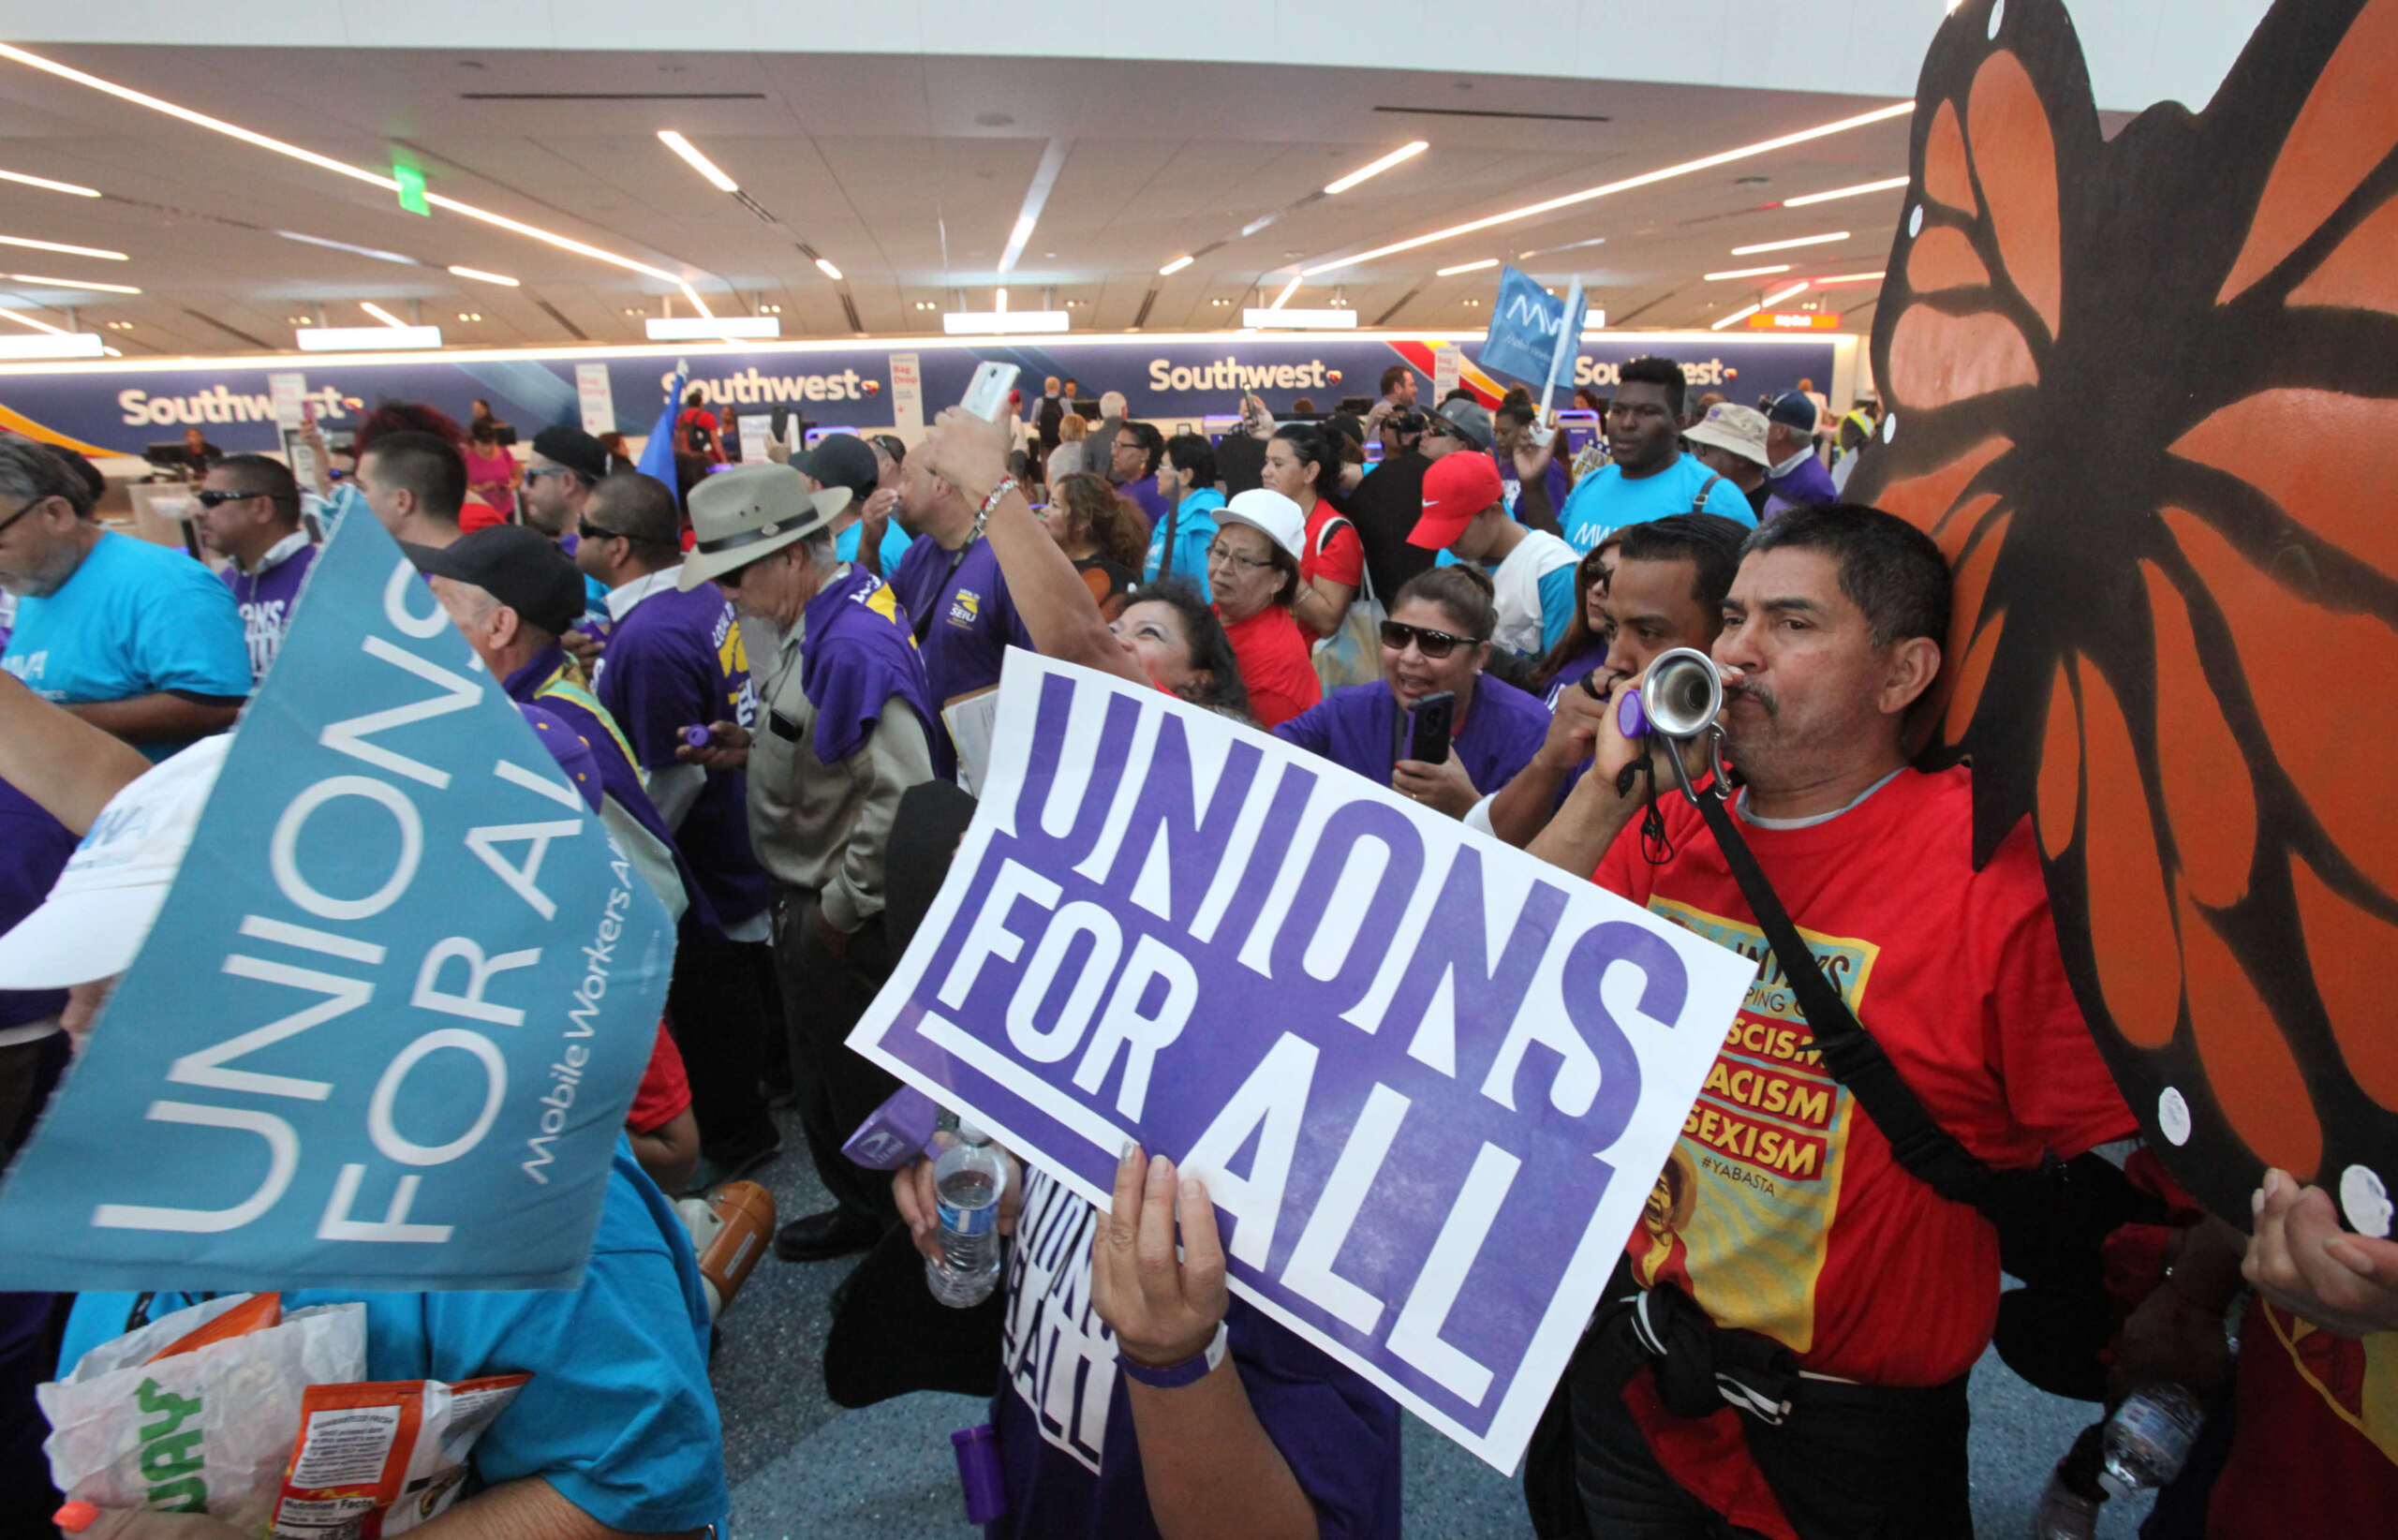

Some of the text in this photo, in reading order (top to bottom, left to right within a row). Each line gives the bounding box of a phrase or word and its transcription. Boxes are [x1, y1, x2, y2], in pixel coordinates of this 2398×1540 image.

[118, 385, 346, 425] Southwst
[1148, 357, 1326, 392] Southwest
[938, 856, 1199, 1122] FOR
[1013, 672, 1689, 1156] UNIONS
[317, 937, 540, 1242] FOR
[521, 1044, 590, 1185] Mobile
[563, 886, 631, 1038] Workers
[1703, 1062, 1830, 1124] ACISM
[1176, 1030, 1523, 1409] ALL
[1681, 1105, 1817, 1177] SEXISM
[1700, 1155, 1776, 1198] #YABASTA
